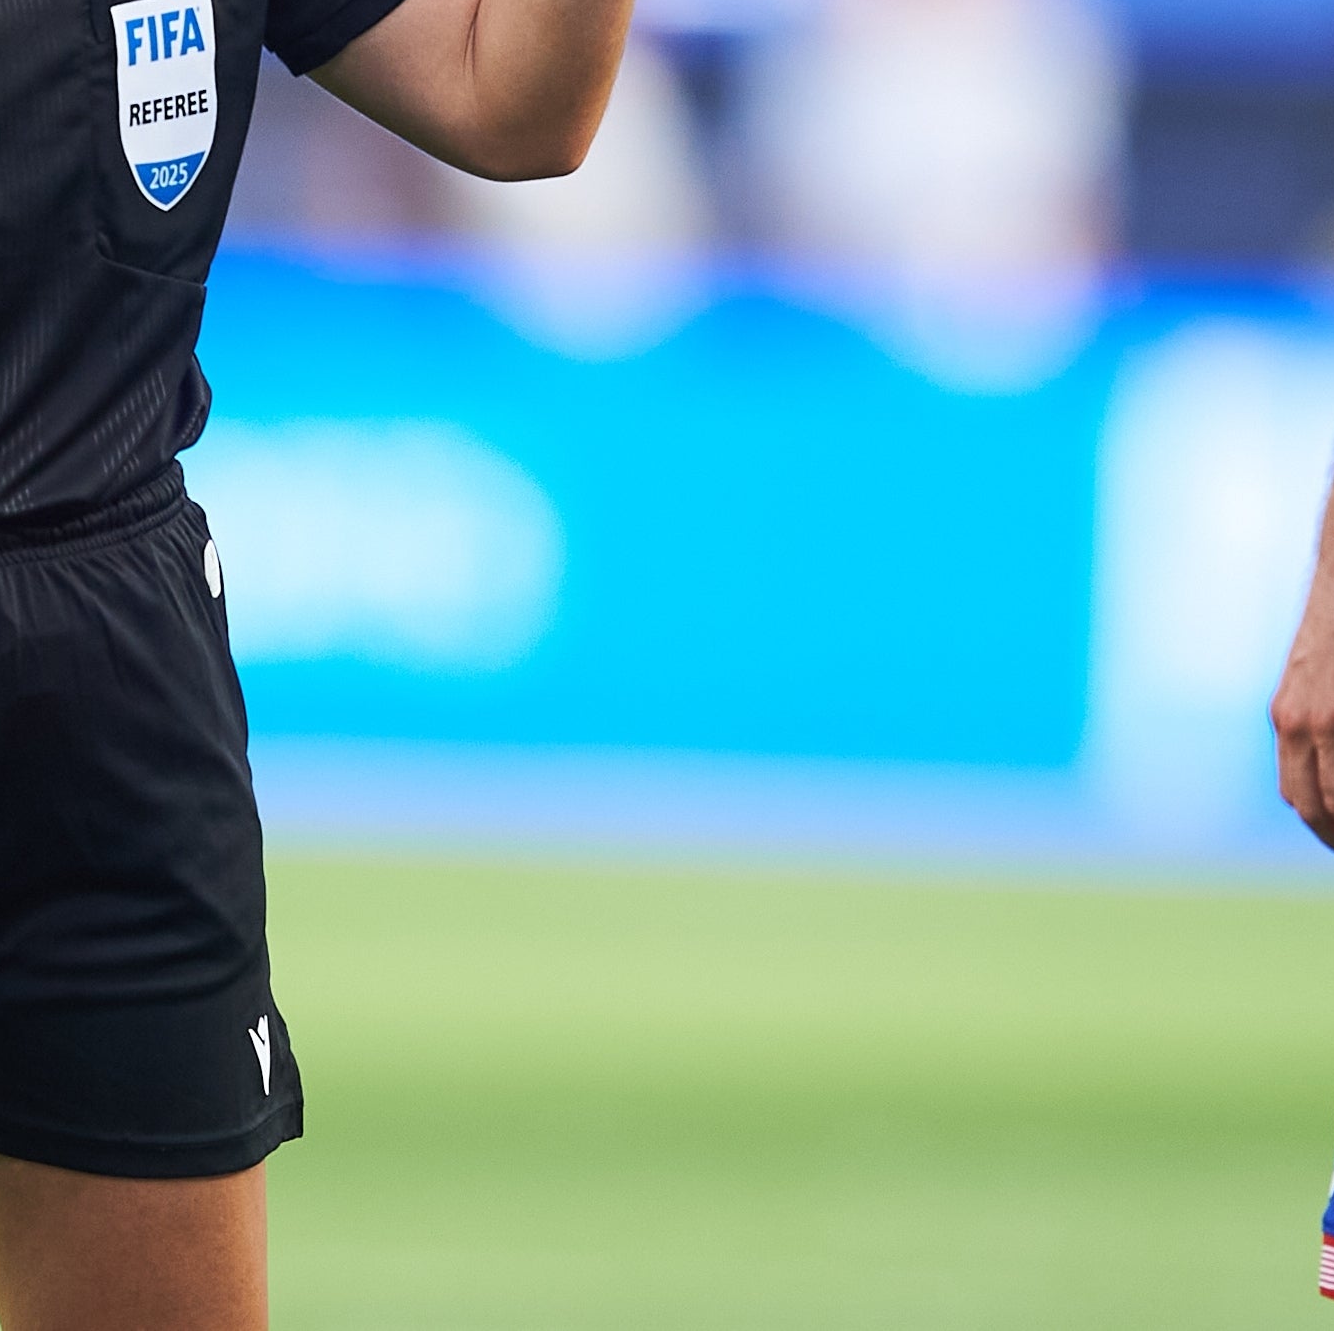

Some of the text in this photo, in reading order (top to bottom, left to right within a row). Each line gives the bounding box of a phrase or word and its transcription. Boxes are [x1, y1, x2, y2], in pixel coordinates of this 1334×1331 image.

[125, 7, 205, 66] FIFA
[129, 89, 209, 127] REFEREE
[149, 162, 188, 189] 2025
